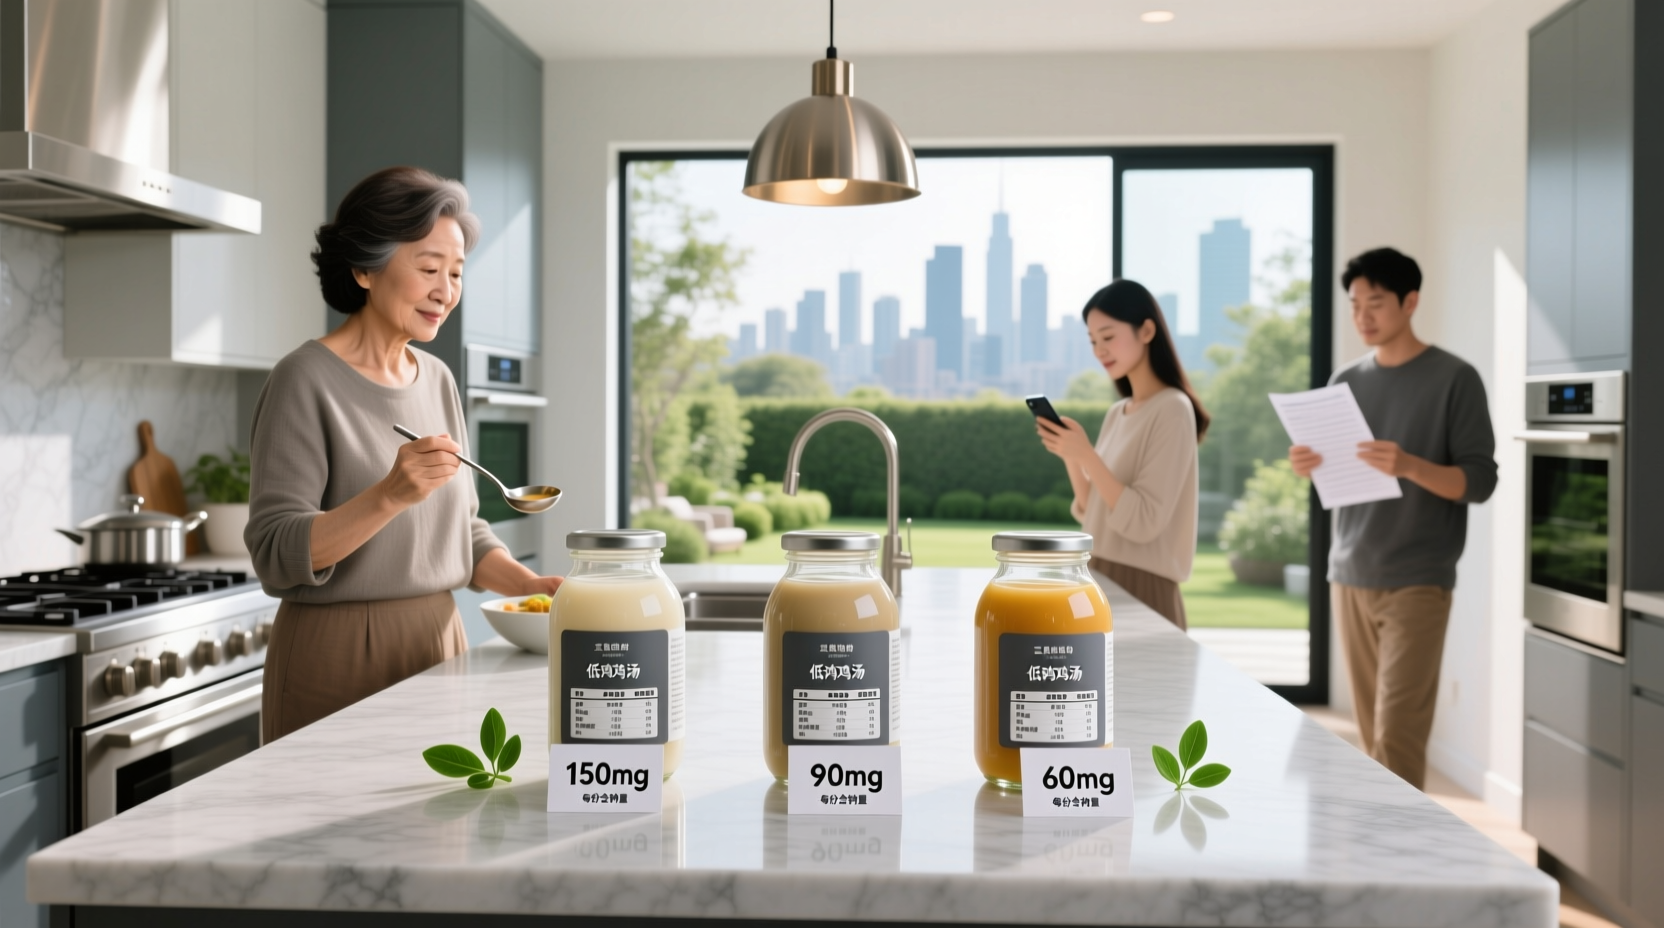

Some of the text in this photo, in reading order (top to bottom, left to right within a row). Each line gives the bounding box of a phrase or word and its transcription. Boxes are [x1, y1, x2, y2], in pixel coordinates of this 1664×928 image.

[566, 761, 649, 792] 150mg
[810, 762, 883, 793] 90mg
[1042, 765, 1115, 796] 60mg
